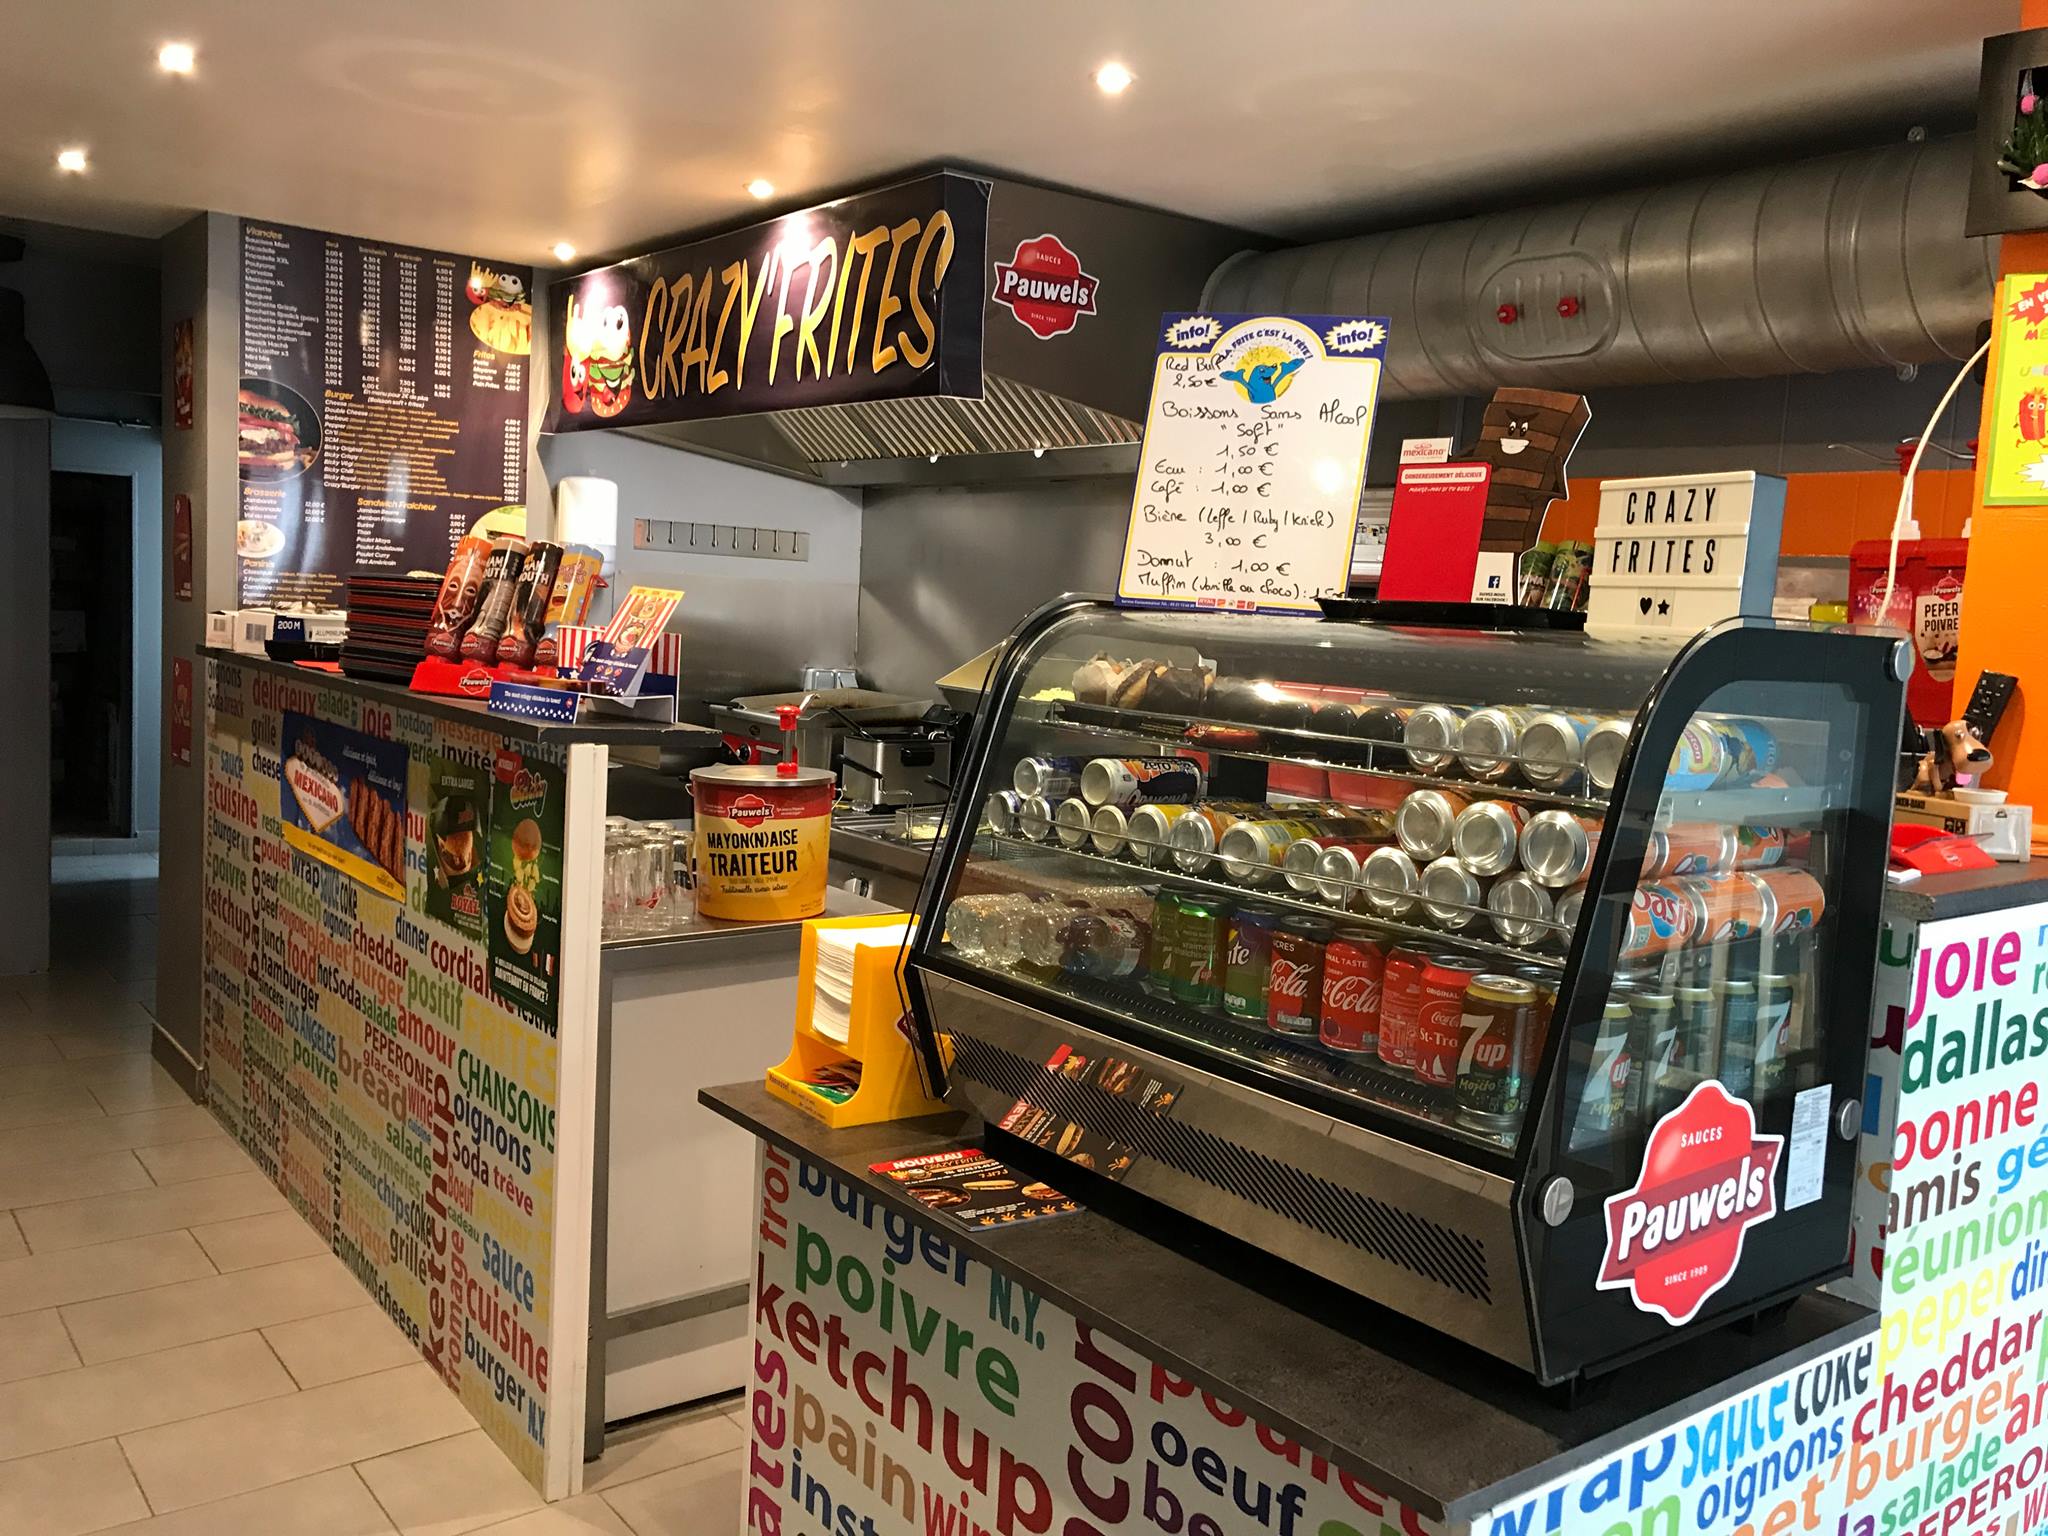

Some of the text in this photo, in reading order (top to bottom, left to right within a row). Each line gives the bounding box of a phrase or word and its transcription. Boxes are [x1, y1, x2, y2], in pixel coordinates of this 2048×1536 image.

[1004, 271, 1089, 305] Pauwels
[2018, 299, 2034, 312] EN
[1176, 323, 1210, 341] info!
[1232, 332, 1254, 349] FRITE
[1257, 329, 1280, 337] C'EST
[1282, 332, 1293, 342] LA
[1337, 328, 1374, 345] info!
[1166, 357, 1189, 370] Red
[324, 390, 354, 400] Burger
[1162, 399, 1367, 426] Boissons Sans Alcool
[1155, 459, 1185, 474] Eau
[1258, 461, 1274, 476] €
[1151, 480, 1183, 503] Café
[1256, 482, 1272, 497] €
[1626, 486, 1718, 525] CRAZY
[1253, 535, 1267, 548] €
[1612, 538, 1716, 574] FRITES
[1239, 584, 1255, 593] ou
[278, 621, 300, 630] 200 M
[1924, 603, 1959, 617] PEPER
[1924, 618, 1959, 631] POIVRE
[432, 717, 499, 753] message
[252, 747, 281, 781] cheese
[214, 777, 258, 829] cuisine
[294, 770, 338, 812] MEXICANO
[731, 807, 770, 817] Pauwels
[707, 829, 798, 849] MAYON(N)AISE
[291, 853, 319, 894] wrap
[709, 850, 798, 876] TRAITEUR
[204, 874, 250, 947] ketchup
[279, 871, 321, 922] chicken
[353, 921, 408, 980] cheddar
[395, 908, 429, 956] dinner
[261, 946, 319, 1012] hamburger
[408, 966, 463, 1031] positif
[1427, 987, 1459, 998] ORIGINAL
[365, 1021, 433, 1094] PEPERONE
[398, 1004, 455, 1069] amour
[293, 1038, 338, 1094] poivre
[338, 1035, 407, 1126] bread
[363, 1049, 400, 1087] glaces
[1459, 1078, 1496, 1096] Mojito
[458, 1048, 555, 1154] CHANSONS
[386, 1122, 432, 1178] salade
[453, 1090, 531, 1175] oignons
[1680, 1126, 1724, 1148] SAUCES
[452, 1130, 489, 1187] Soda
[893, 1152, 963, 1169] NOUVEAU
[377, 1172, 410, 1226] chips
[493, 1165, 534, 1216] trêve
[1618, 1156, 1766, 1261] Pauwels
[448, 1205, 479, 1240] cadeau
[389, 1228, 427, 1286] grillé
[482, 1232, 534, 1312] sauce
[1664, 1265, 1708, 1286] SINCE 1909
[378, 1281, 419, 1347] cheese
[795, 1222, 1020, 1418] poivre
[988, 1266, 1046, 1351] N.Y.
[466, 1277, 548, 1394] cuisine
[465, 1317, 526, 1414] burger
[1852, 1308, 2043, 1446] cheddar
[755, 1250, 1053, 1536] ketchup
[792, 1383, 916, 1523] pain
[1696, 1415, 1844, 1531] oignons
[1880, 1431, 2001, 1536] salade
